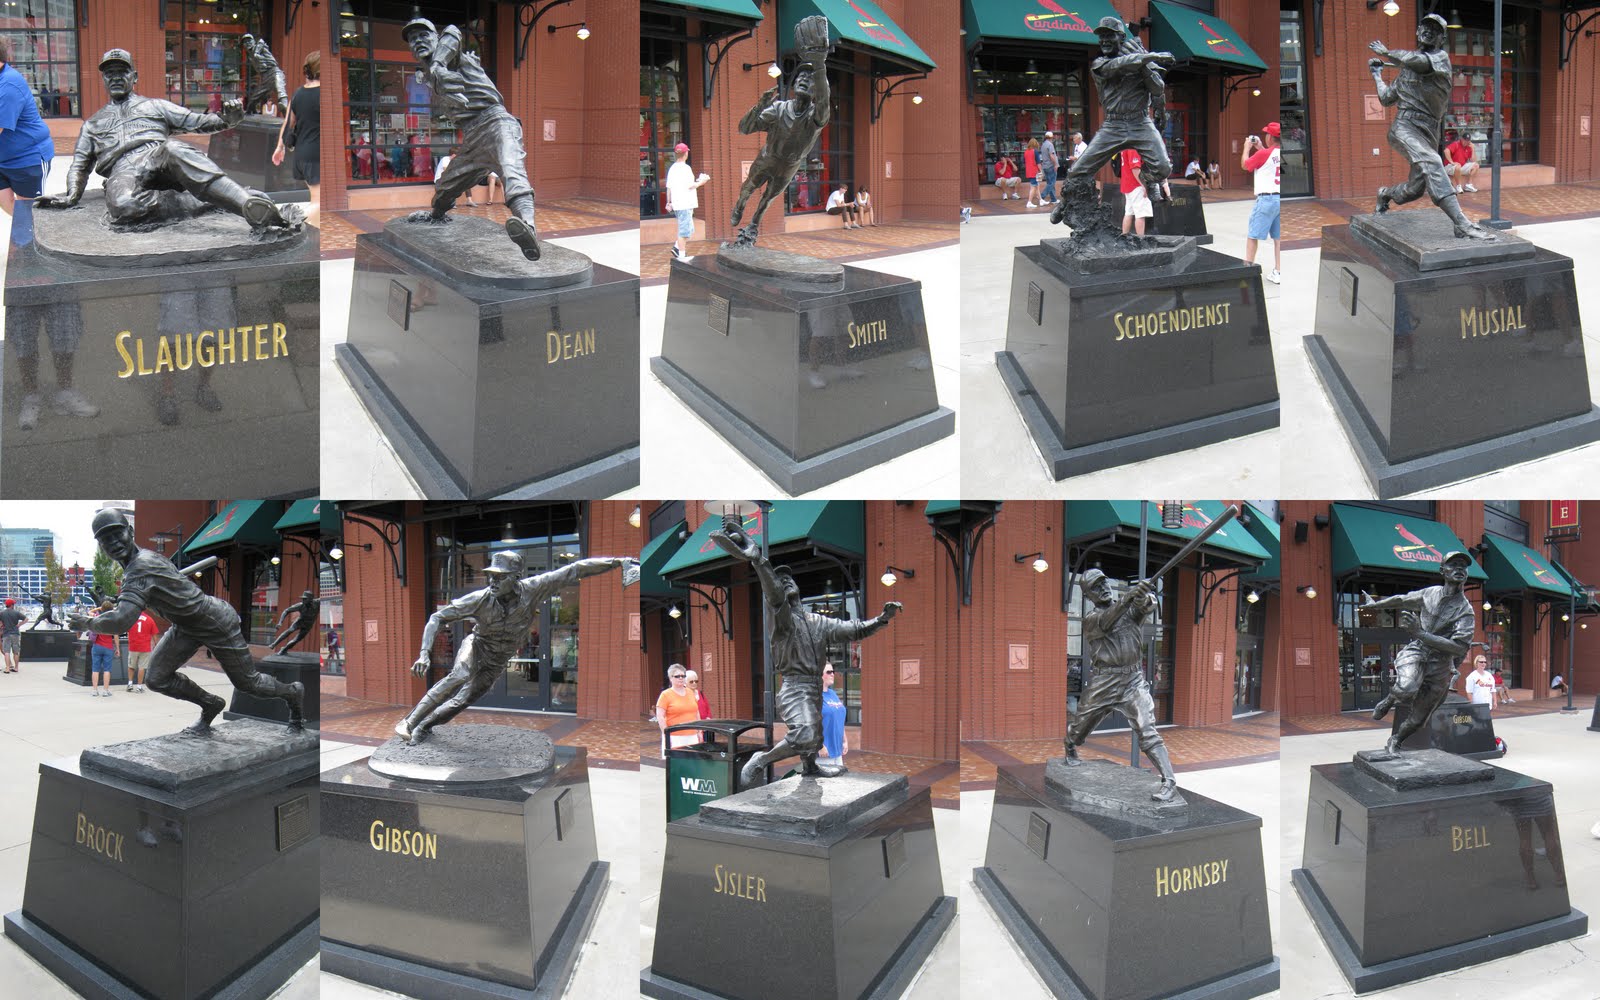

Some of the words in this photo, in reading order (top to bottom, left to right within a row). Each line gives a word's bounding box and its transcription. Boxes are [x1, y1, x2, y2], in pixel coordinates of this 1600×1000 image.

[1023, 13, 1094, 33] Cardinals
[847, 320, 887, 349] SMITH
[1115, 302, 1230, 341] SCHOENDIENST
[1460, 305, 1526, 339] MUSIAL
[115, 321, 289, 379] SLAUGHTER
[546, 328, 595, 364] DEAN
[1392, 545, 1443, 563] Cardinal
[1452, 714, 1473, 724] GIBSON
[680, 776, 718, 793] WM
[75, 812, 124, 863] BROCK
[369, 819, 438, 860] GIBSON
[1451, 826, 1491, 853] BELL
[713, 863, 767, 903] SISLER
[1155, 858, 1229, 898] HORNSBY
